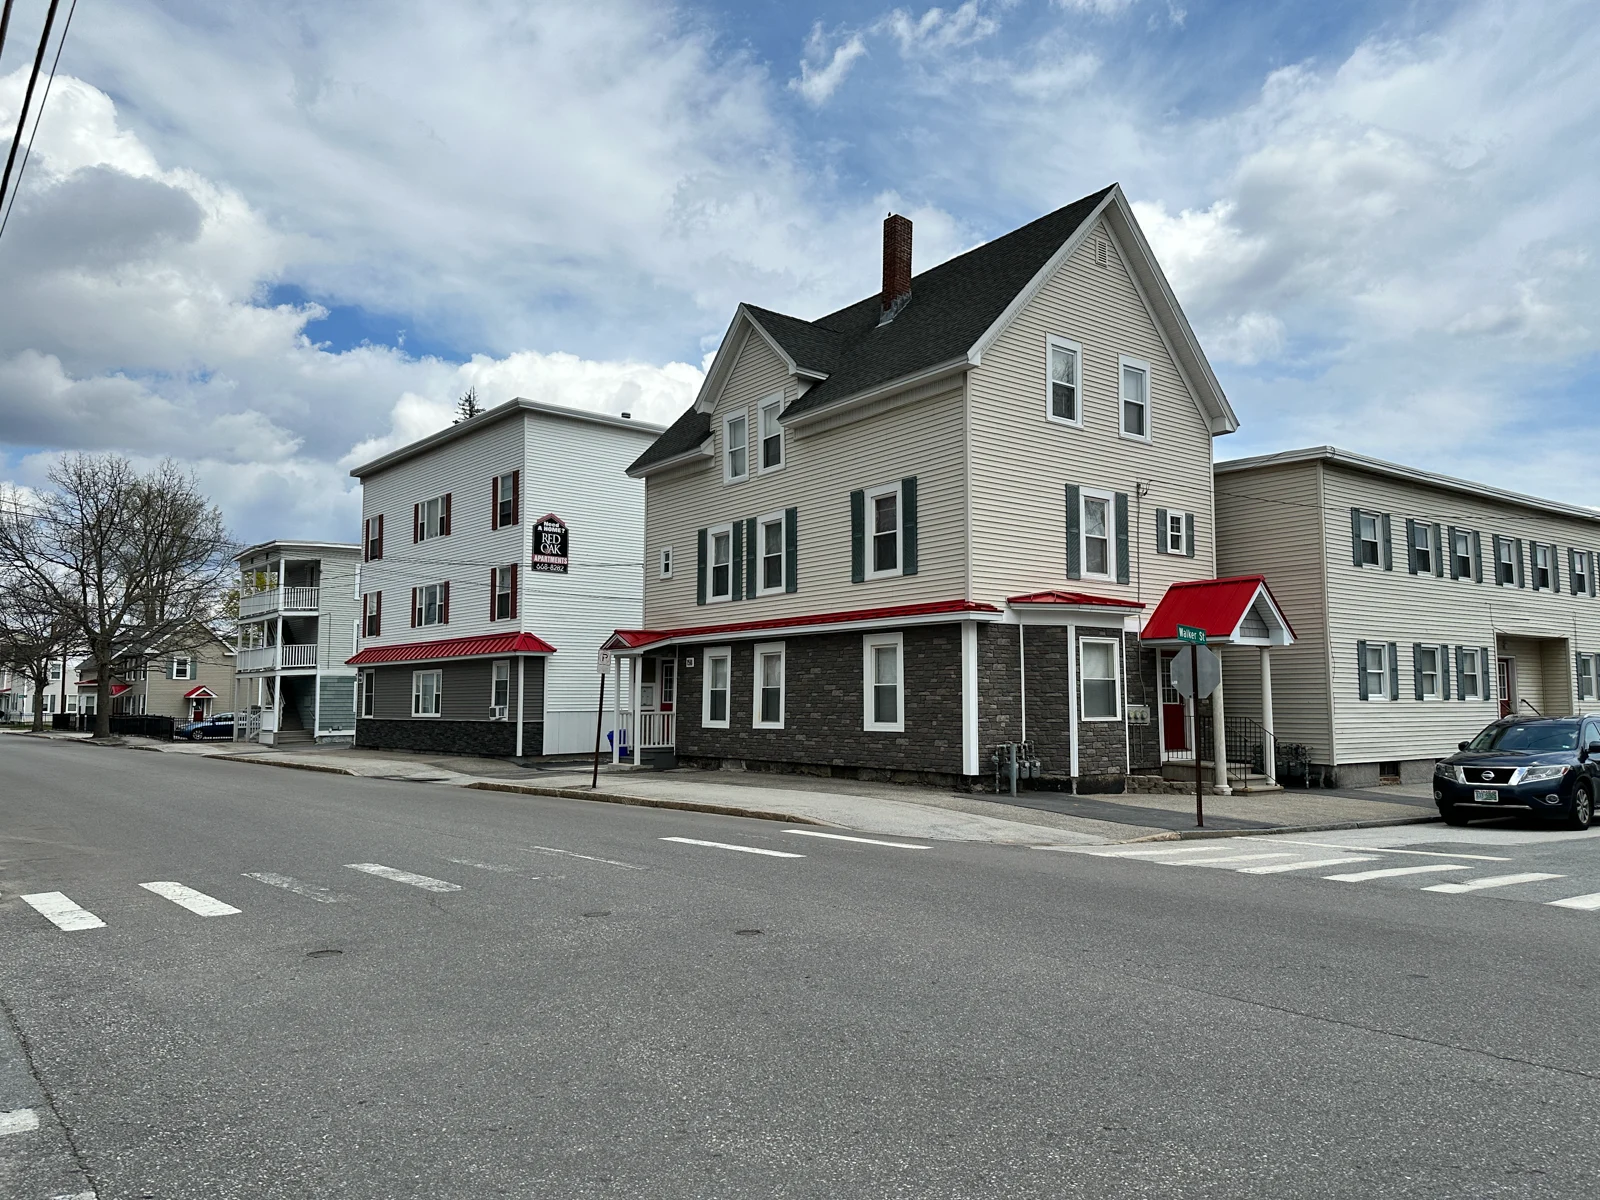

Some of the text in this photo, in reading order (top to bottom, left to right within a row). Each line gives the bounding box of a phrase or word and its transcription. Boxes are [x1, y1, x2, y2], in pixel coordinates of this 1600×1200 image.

[543, 526, 565, 534] HOME?
[541, 533, 561, 545] RED
[540, 543, 561, 554] OAK
[533, 554, 568, 565] APARTMENTS
[1178, 627, 1206, 641] Walker St
